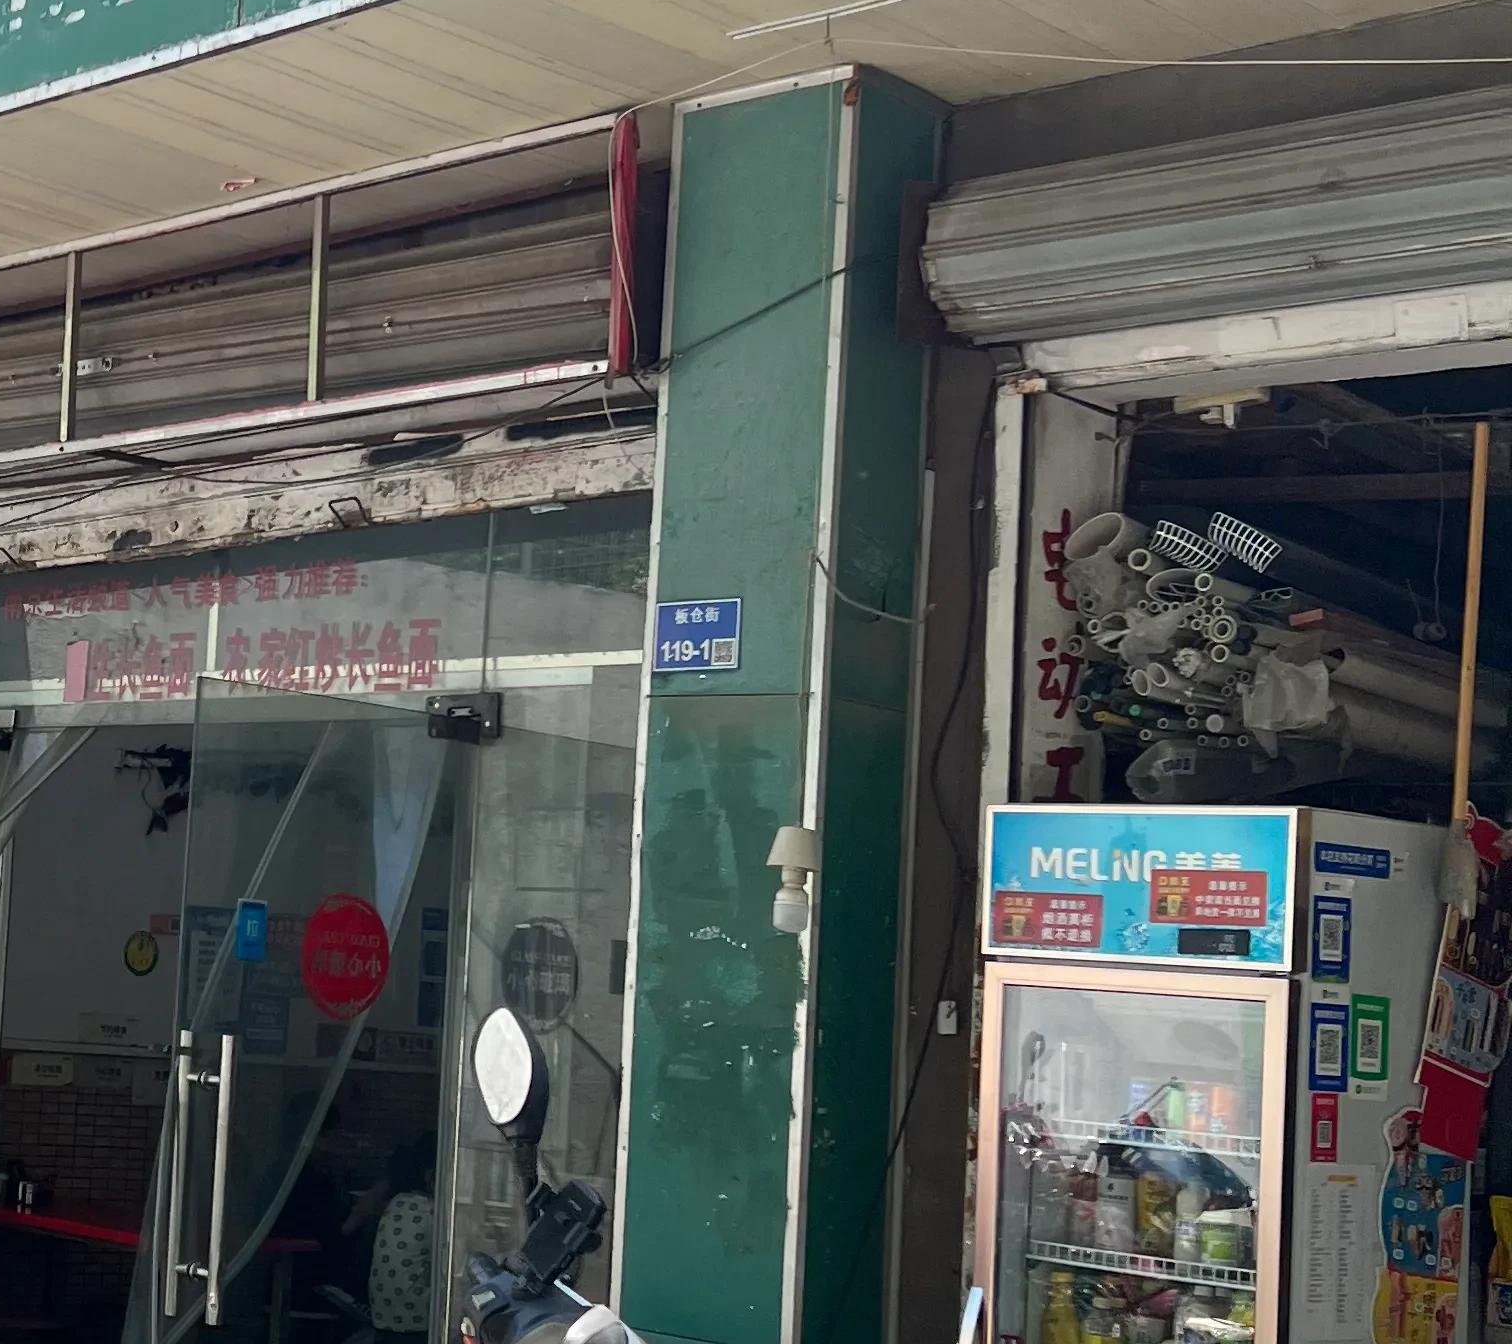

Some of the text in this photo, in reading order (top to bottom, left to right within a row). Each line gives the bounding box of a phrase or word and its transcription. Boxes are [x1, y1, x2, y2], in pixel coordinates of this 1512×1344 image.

[675, 607, 720, 625] 板仓街
[660, 638, 711, 662] 119-1
